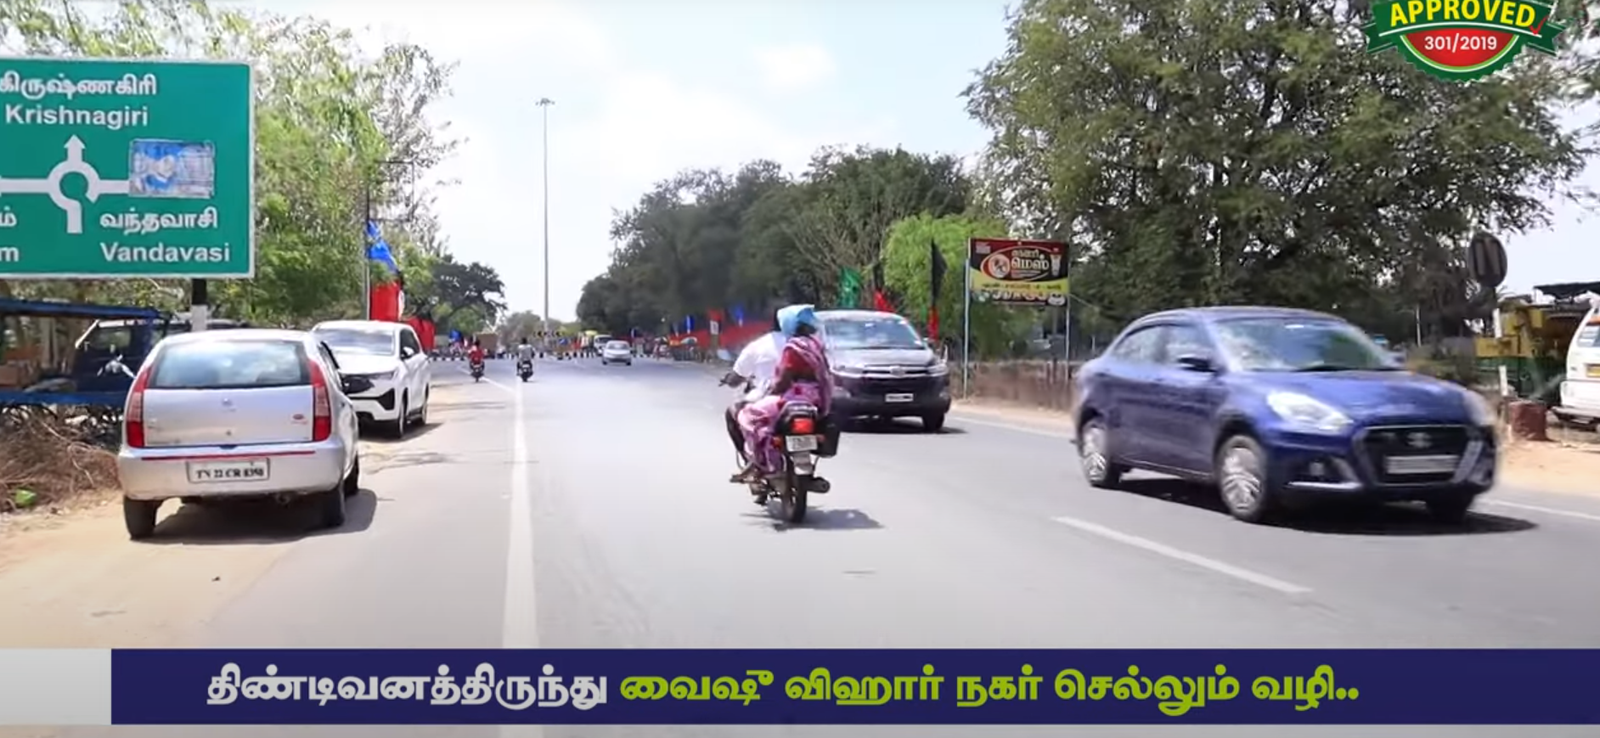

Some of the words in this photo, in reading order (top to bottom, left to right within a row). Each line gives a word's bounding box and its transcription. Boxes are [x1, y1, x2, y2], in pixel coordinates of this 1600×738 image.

[5, 104, 148, 130] Krishnagiri
[100, 206, 218, 234] வந்தவாசி
[100, 242, 230, 262] Vandavasi
